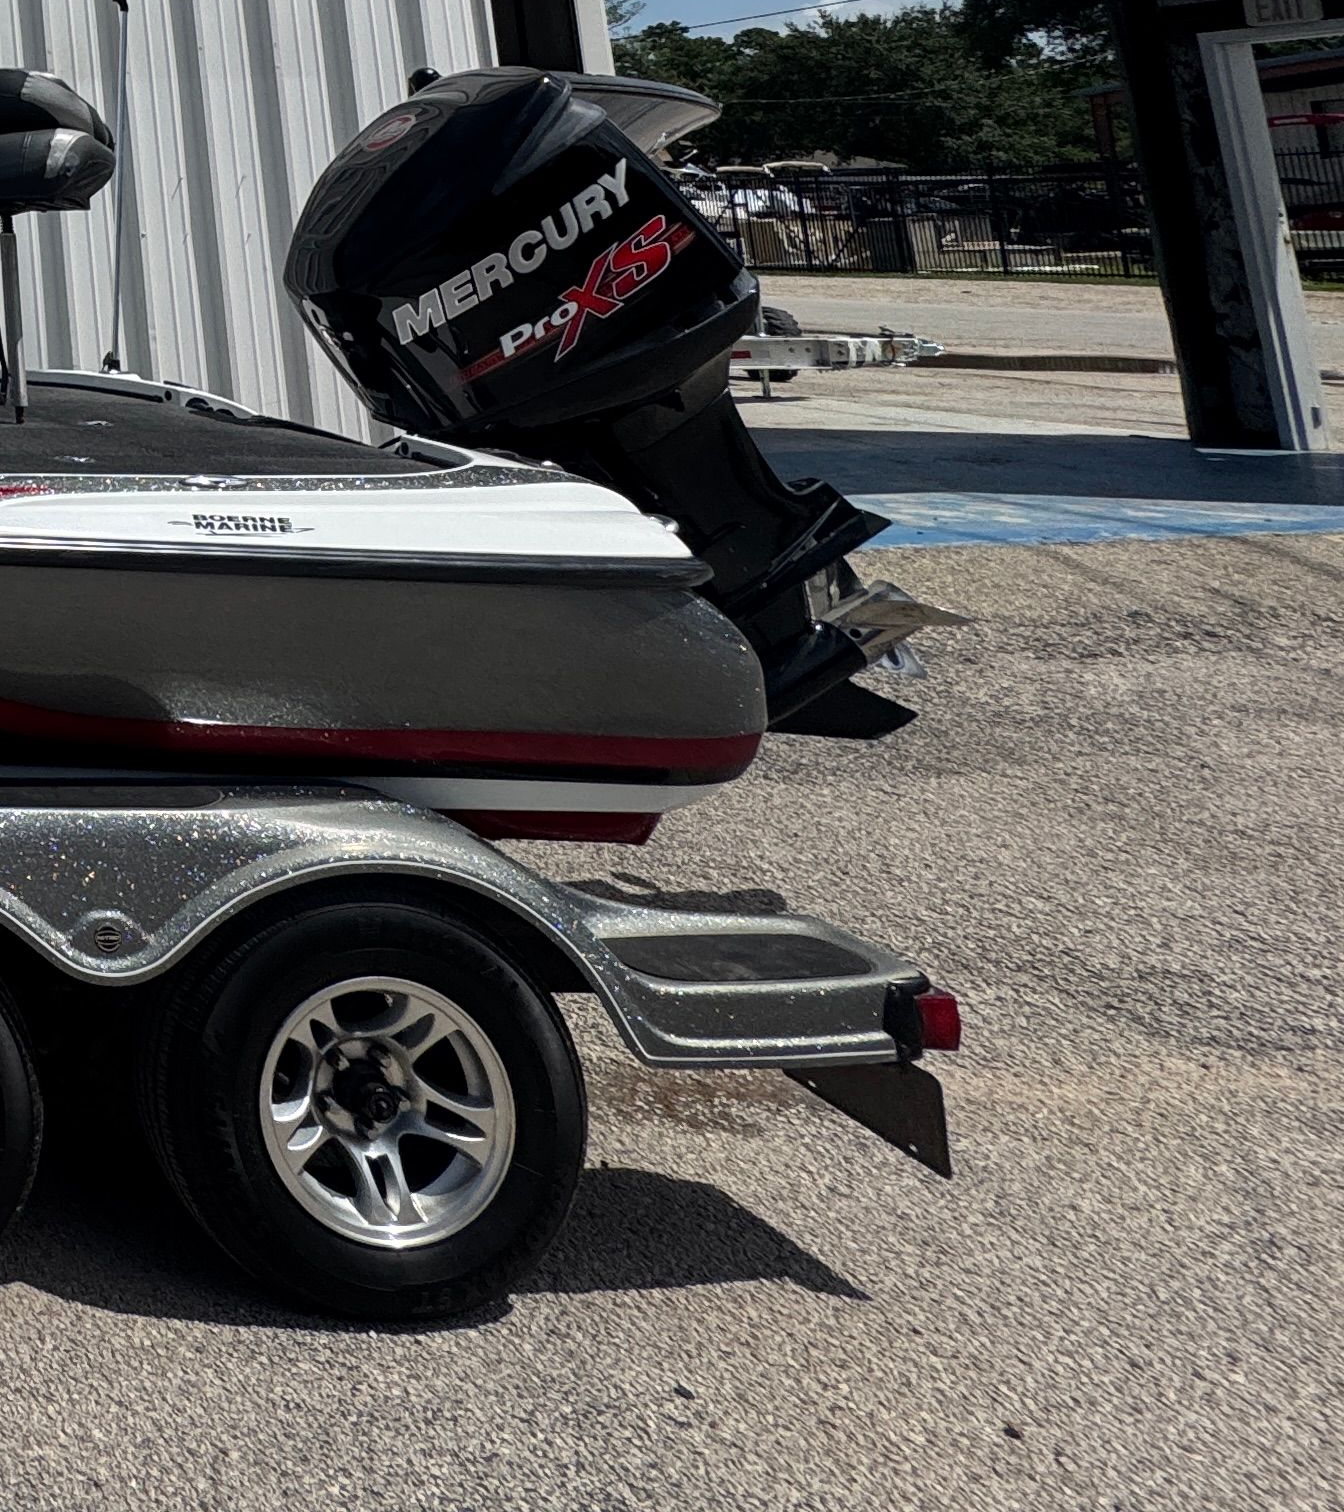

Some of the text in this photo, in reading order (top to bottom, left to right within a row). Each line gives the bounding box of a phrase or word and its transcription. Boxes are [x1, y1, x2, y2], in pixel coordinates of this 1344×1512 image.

[392, 157, 630, 346] MERCURY
[192, 514, 291, 525] BOERNE
[194, 521, 294, 534] MARINE
